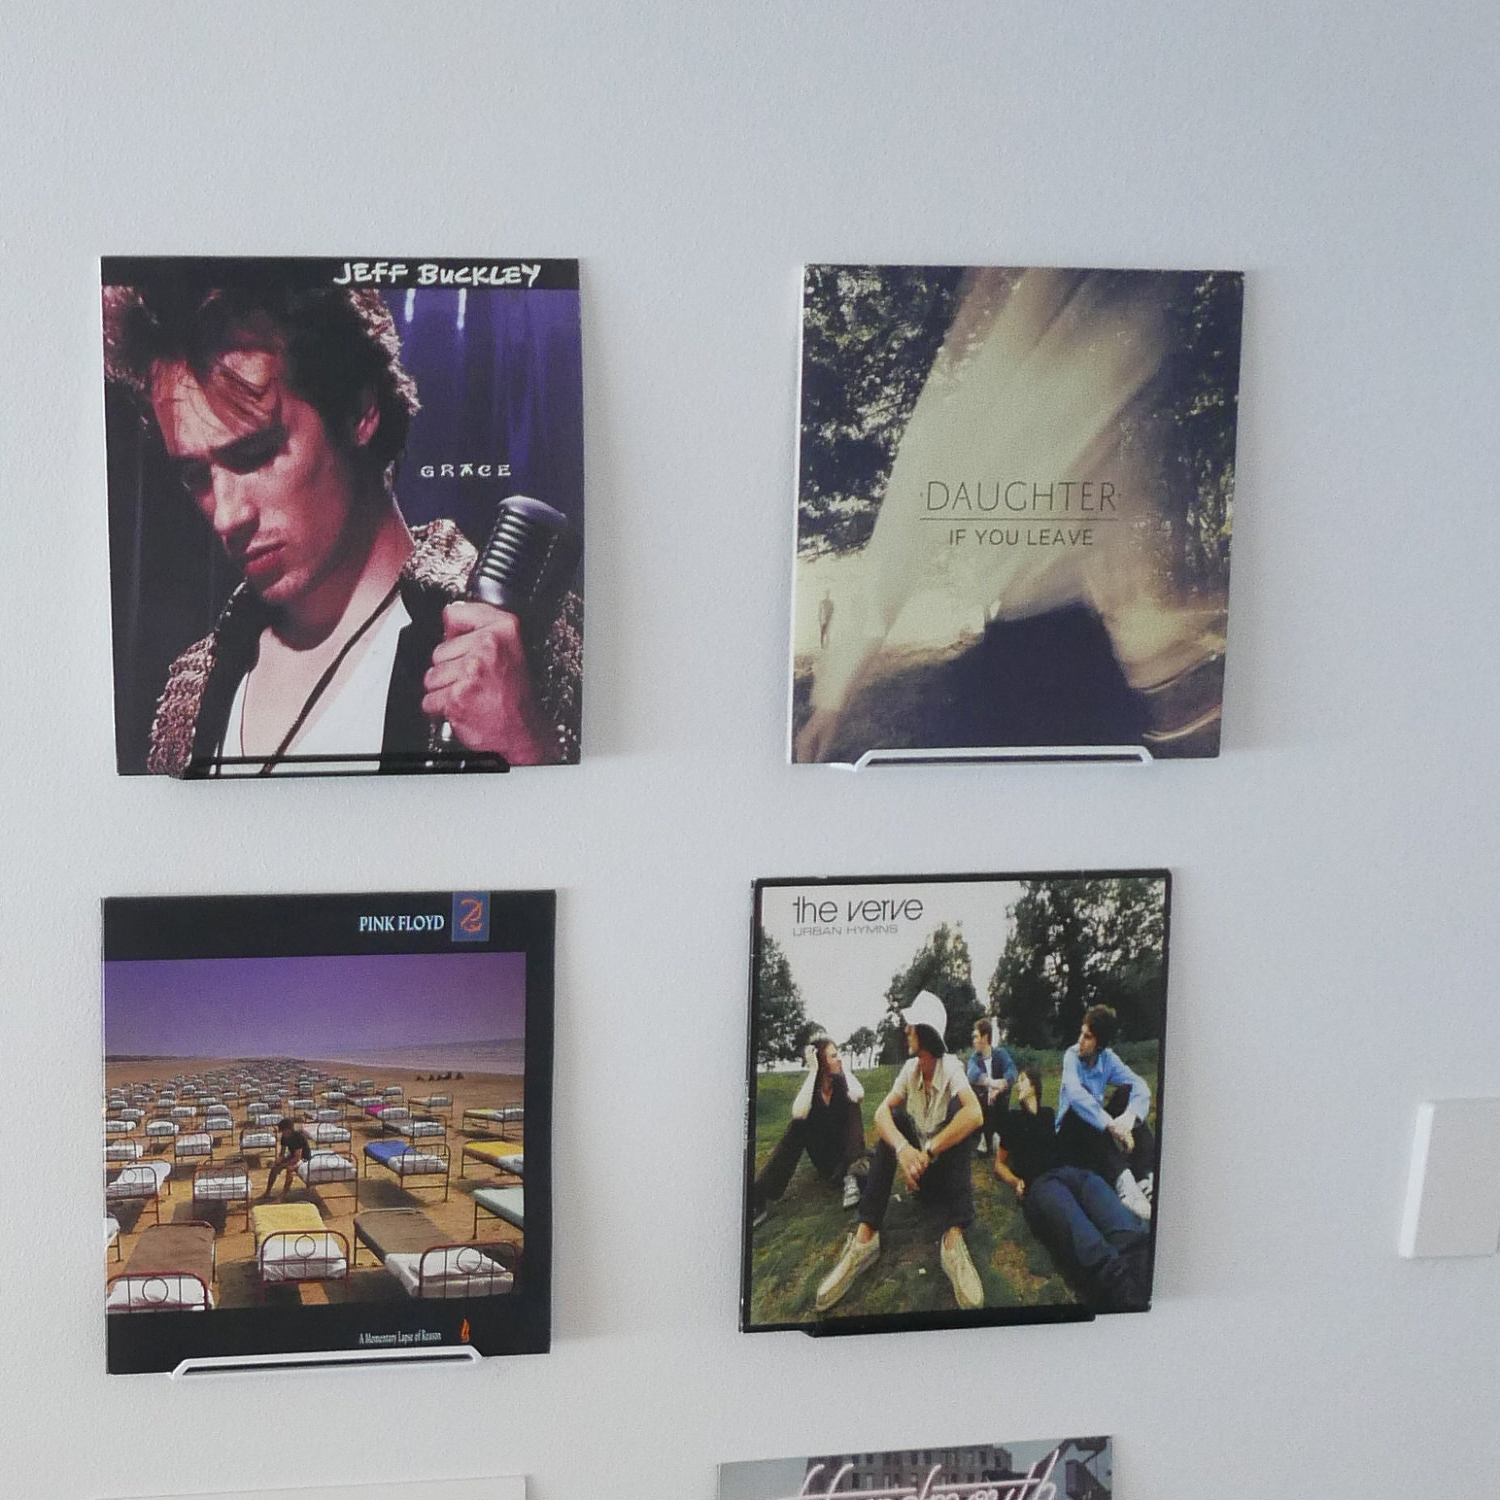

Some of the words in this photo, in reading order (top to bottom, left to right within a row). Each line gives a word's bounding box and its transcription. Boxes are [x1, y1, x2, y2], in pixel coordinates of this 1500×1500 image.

[332, 261, 409, 286] JEFF
[417, 263, 542, 288] BUCKLEY
[420, 463, 512, 478] GRACE
[926, 480, 1117, 512] DAUGHTER
[949, 529, 966, 546] IF
[974, 529, 1019, 546] YOU
[1026, 529, 1094, 546] LEAVE
[792, 896, 838, 924] the
[847, 899, 924, 922] verve
[359, 915, 395, 932] PINK
[398, 914, 445, 931] FLOYD
[792, 926, 843, 938] URBAN
[846, 923, 899, 936] HYMNS
